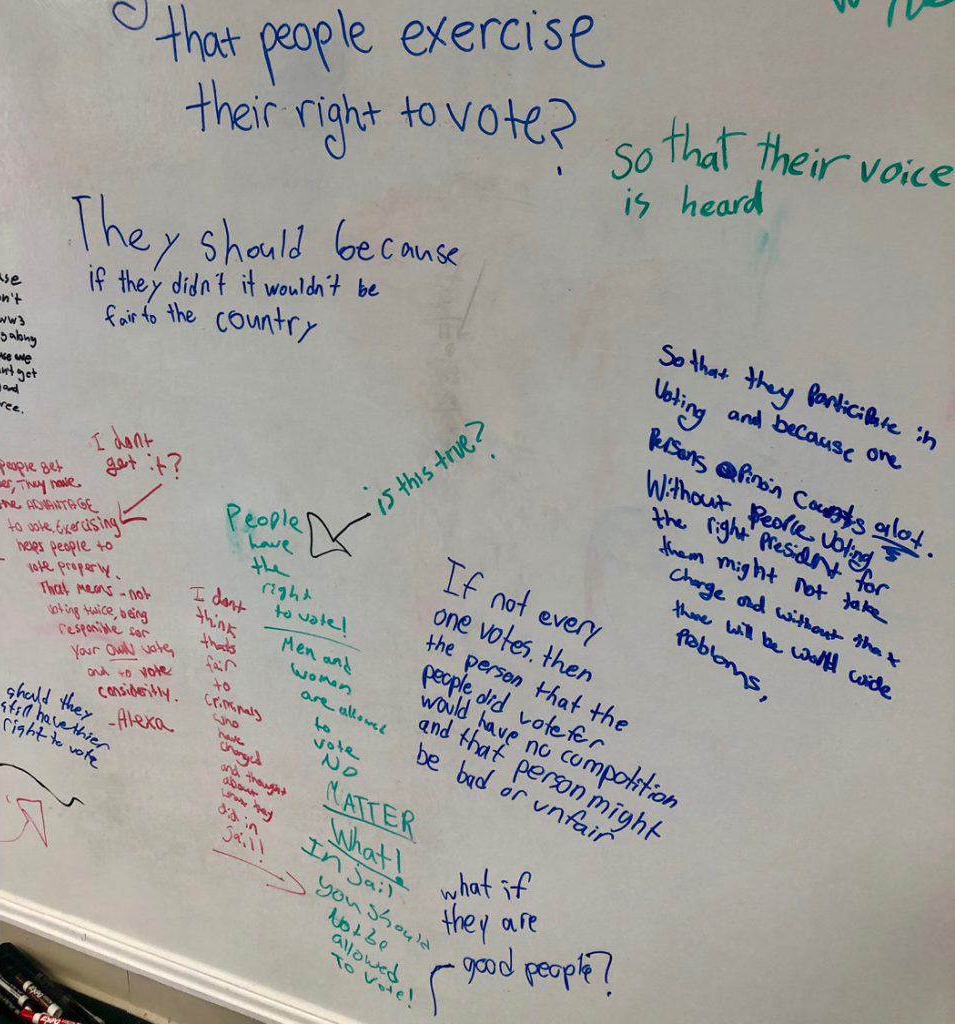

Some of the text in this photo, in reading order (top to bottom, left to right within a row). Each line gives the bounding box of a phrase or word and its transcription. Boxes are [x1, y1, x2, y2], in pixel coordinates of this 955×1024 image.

[154, 3, 606, 87] that people exercise
[185, 80, 578, 177] their right to vote?
[661, 115, 953, 188] that their voice
[624, 183, 764, 220] is heard
[70, 193, 460, 271] They should because
[88, 264, 380, 304] if they didn't it wouldn't be
[104, 301, 319, 345] fair to the country
[727, 409, 855, 464] and because
[395, 465, 435, 497] this
[646, 467, 733, 512] Without
[225, 502, 304, 535] People
[715, 556, 779, 585] might
[274, 603, 293, 620] to
[442, 556, 603, 648] If not every
[433, 608, 593, 683] one then
[5, 681, 94, 720] should they
[421, 663, 512, 714] people did
[425, 633, 629, 732] the person that the
[420, 694, 472, 720] would
[477, 708, 520, 746] have
[415, 741, 616, 843] be bad or unfair
[418, 718, 666, 842] and that person might
[326, 780, 417, 836] MATTER
[440, 867, 533, 901] what if
[441, 902, 538, 946] they are
[462, 946, 516, 985] good
